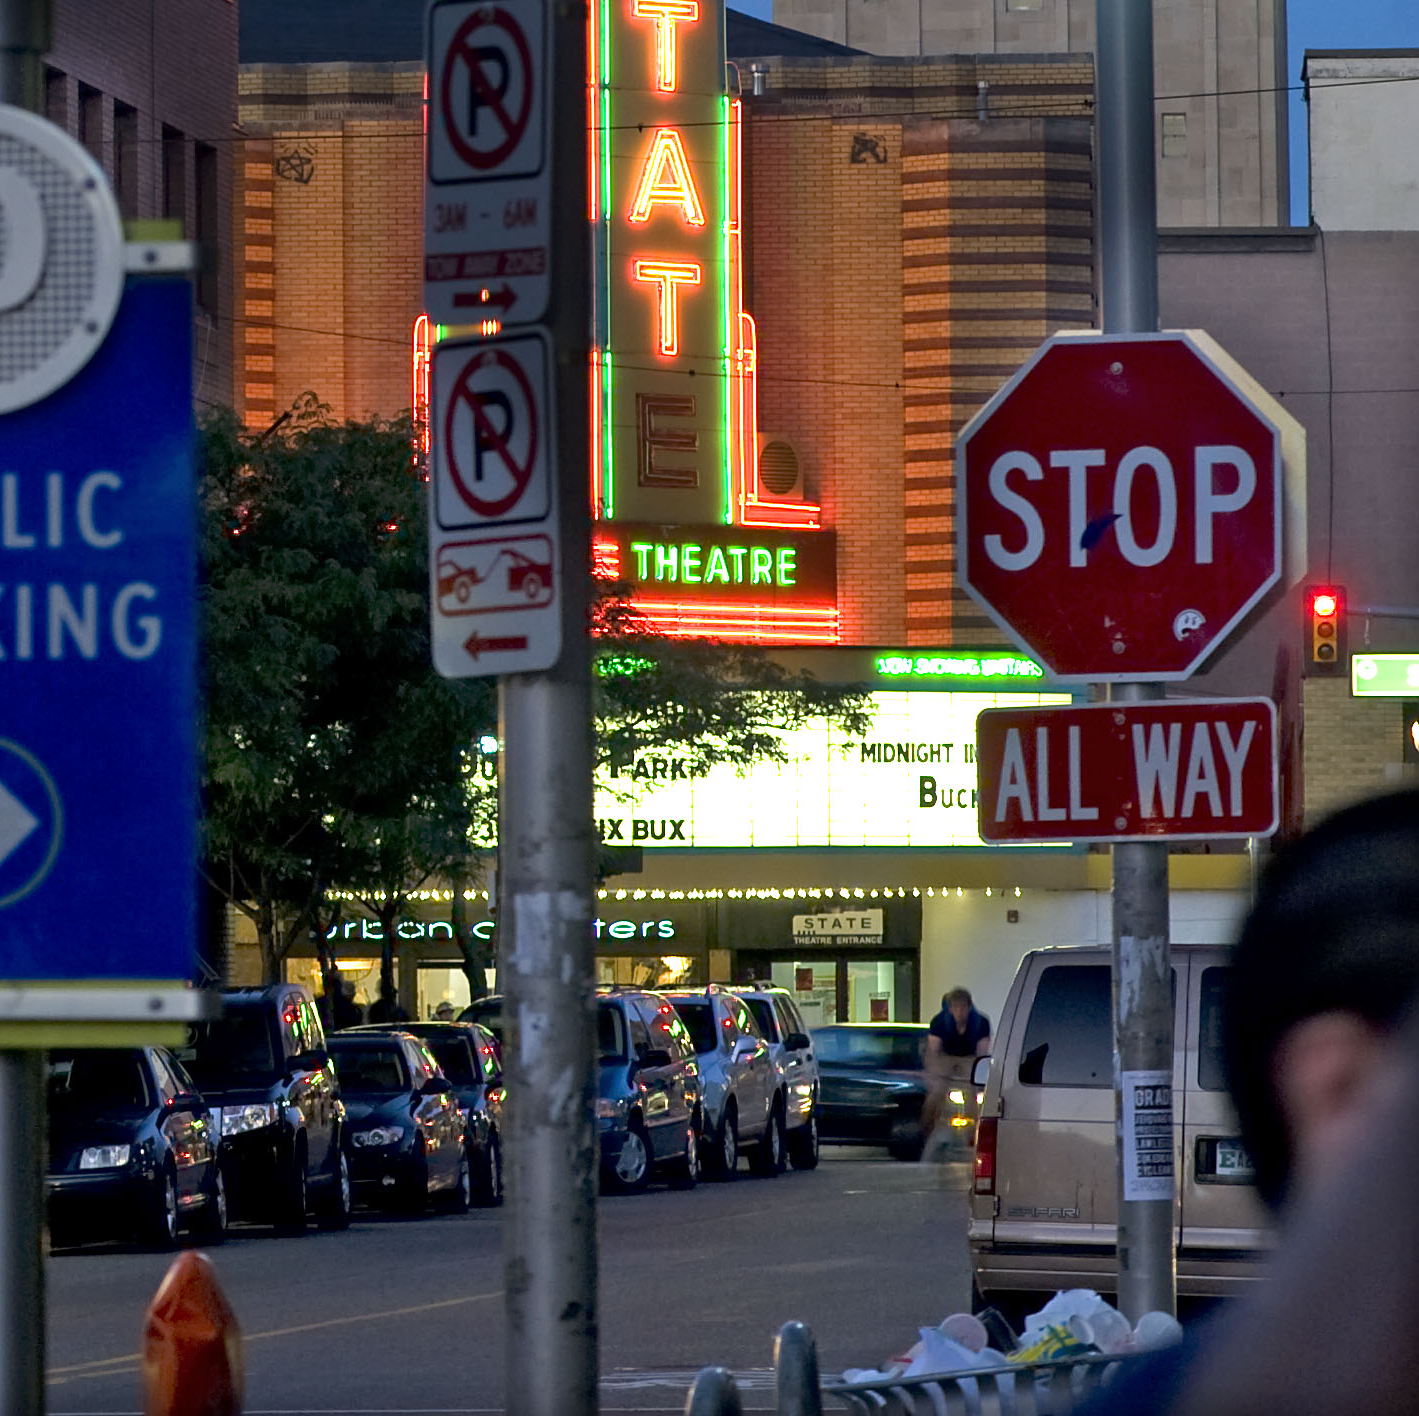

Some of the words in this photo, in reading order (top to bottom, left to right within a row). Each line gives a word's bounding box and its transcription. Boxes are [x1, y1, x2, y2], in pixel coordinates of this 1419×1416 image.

[984, 445, 1257, 571] STOP
[631, 541, 799, 587] THEATRE
[860, 742, 954, 764] MIDNIGHT
[994, 726, 1099, 823] ALL
[1131, 720, 1257, 819] WAY
[632, 819, 686, 840] BUX
[804, 916, 872, 930] STATE
[793, 936, 833, 945] THEATRE
[836, 935, 883, 945] ENTRANCE
[1007, 1207, 1081, 1219] SAFARI
